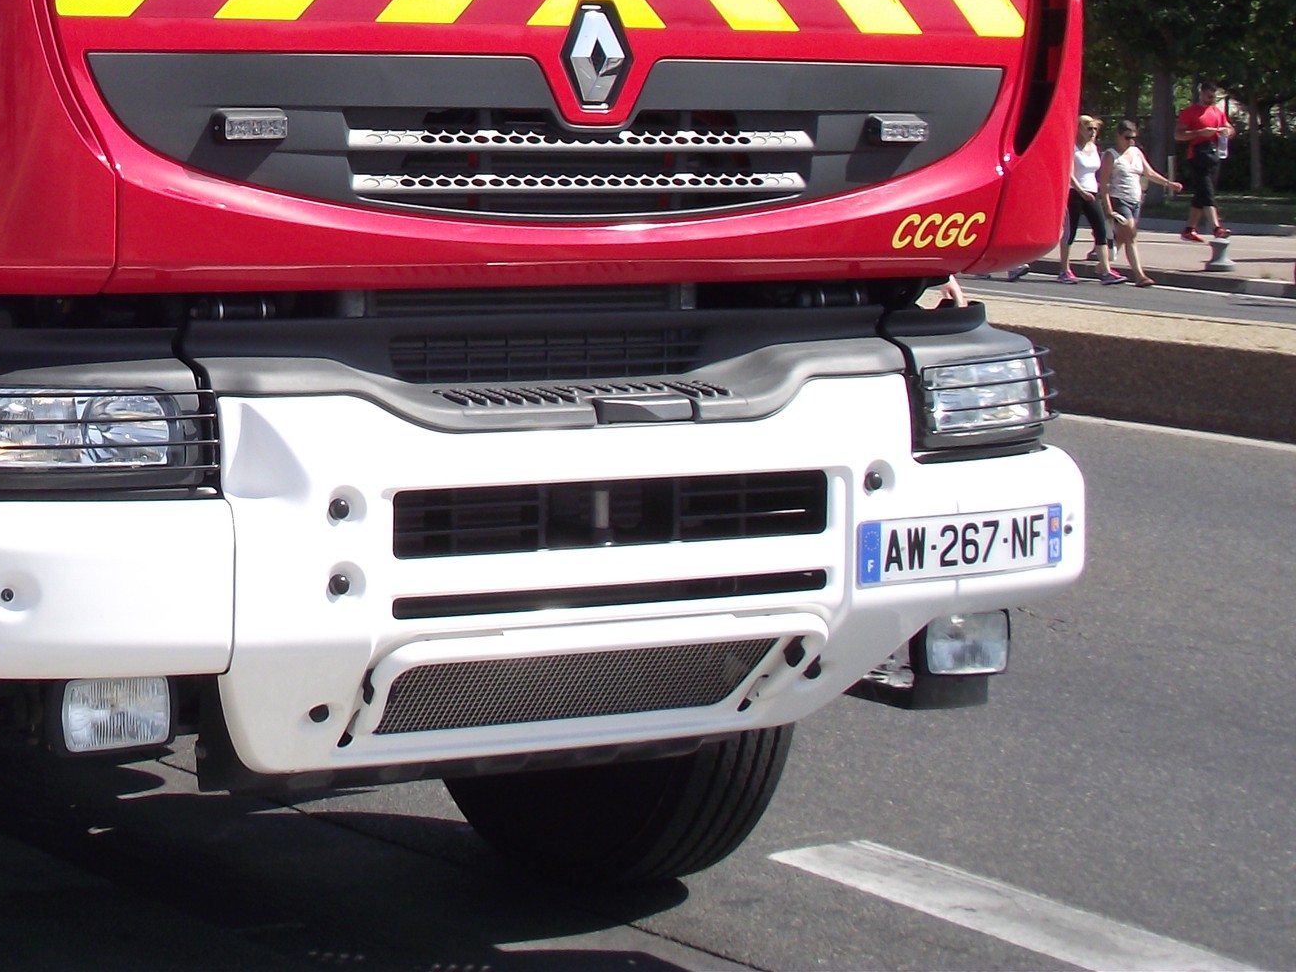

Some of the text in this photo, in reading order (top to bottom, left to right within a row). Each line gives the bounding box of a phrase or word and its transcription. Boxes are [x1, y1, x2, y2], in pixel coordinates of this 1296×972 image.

[892, 212, 986, 249] CCGC
[1049, 537, 1060, 558] 13
[867, 559, 875, 573] F
